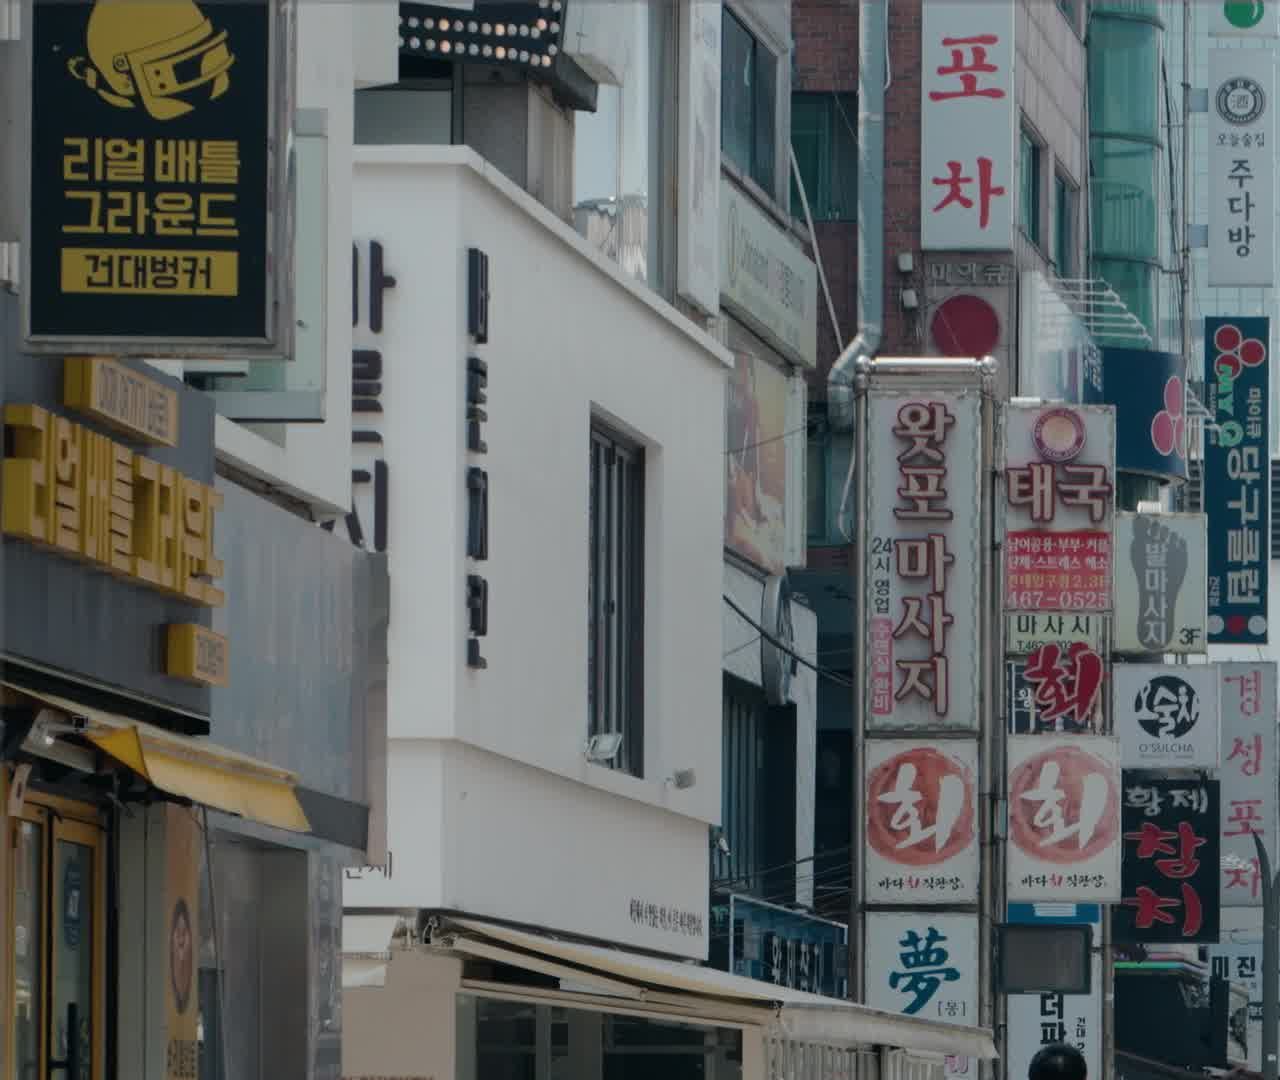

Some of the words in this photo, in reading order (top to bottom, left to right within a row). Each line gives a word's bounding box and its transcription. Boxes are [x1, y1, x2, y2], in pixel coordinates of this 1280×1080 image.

[63, 138, 145, 183] 리얼
[153, 140, 240, 184] 배틀
[929, 34, 1006, 229] 포차
[62, 191, 239, 236] 그라운드
[1227, 159, 1256, 258] 주다방
[84, 254, 213, 289] 건대벙커
[892, 401, 957, 522] 왓포
[1005, 464, 1111, 523] 태국
[1226, 446, 1261, 605] 당구클럽
[875, 579, 890, 614] 영업
[892, 533, 957, 718] 마사지
[1143, 542, 1170, 646] 발마사지
[1178, 627, 1202, 646] 3F
[877, 761, 966, 854] 회
[1018, 760, 1109, 851] 회
[1125, 785, 1209, 814] 황제
[888, 926, 961, 1016] 夢
